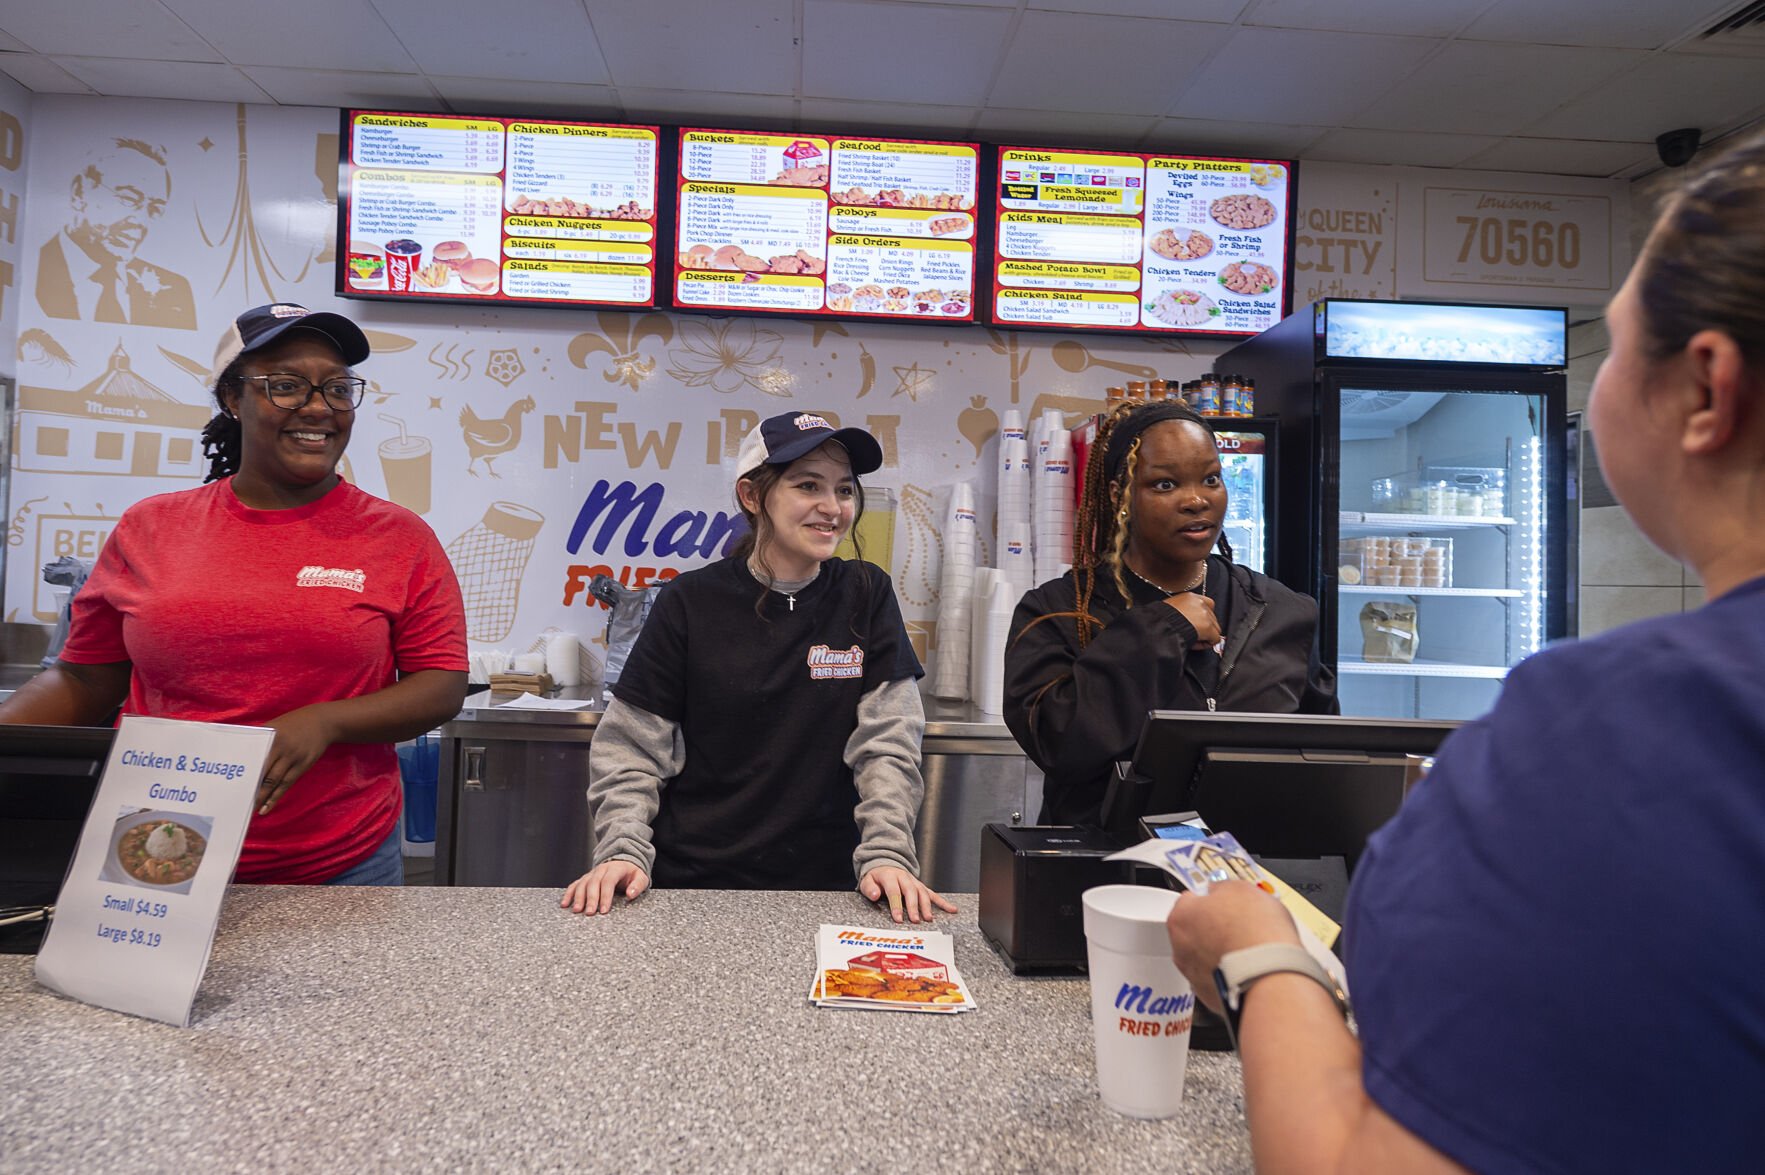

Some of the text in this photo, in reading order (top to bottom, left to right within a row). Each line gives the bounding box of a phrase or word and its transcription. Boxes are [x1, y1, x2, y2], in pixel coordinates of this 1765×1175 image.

[361, 116, 428, 128] Sandwiches
[514, 125, 559, 134] Chicken
[564, 128, 608, 137] Dinners
[690, 134, 734, 142] Buckets
[840, 142, 881, 151] Seafood
[1010, 153, 1051, 161] Drinks
[1154, 160, 1241, 172] Party Platters
[360, 172, 405, 182] Combos
[689, 185, 735, 194] Specials
[1075, 188, 1117, 196] Squeezed
[1476, 194, 1560, 212] Louisiana
[836, 208, 877, 218] Poboys
[510, 219, 602, 230] Chicken Nuggets
[1037, 216, 1062, 224] Meal
[1309, 208, 1382, 234] QUEEN
[511, 241, 555, 249] Biscuits
[836, 237, 900, 246] Side Orders
[1231, 243, 1260, 251] Shrimp
[1456, 216, 1580, 269] 70560
[1296, 235, 1382, 275] CITY
[510, 262, 548, 271] Salads
[1047, 265, 1078, 273] Potato
[686, 273, 735, 282] Desserts
[1004, 291, 1048, 299] Chicken
[1223, 307, 1271, 315] Sandwiches
[543, 401, 683, 470] NEW
[1216, 438, 1240, 449] OLD
[297, 566, 366, 583] Mama's
[810, 647, 862, 665] Mama's
[813, 666, 861, 677] FRIED CHICKEN
[122, 750, 246, 780] Chicken & Sausage
[149, 784, 197, 803] Gumbo
[102, 895, 168, 918] Small $4.59
[97, 922, 161, 948] Large $8.19
[838, 931, 925, 945] Mama's
[1119, 1016, 1192, 1037] FRIED CHIC
